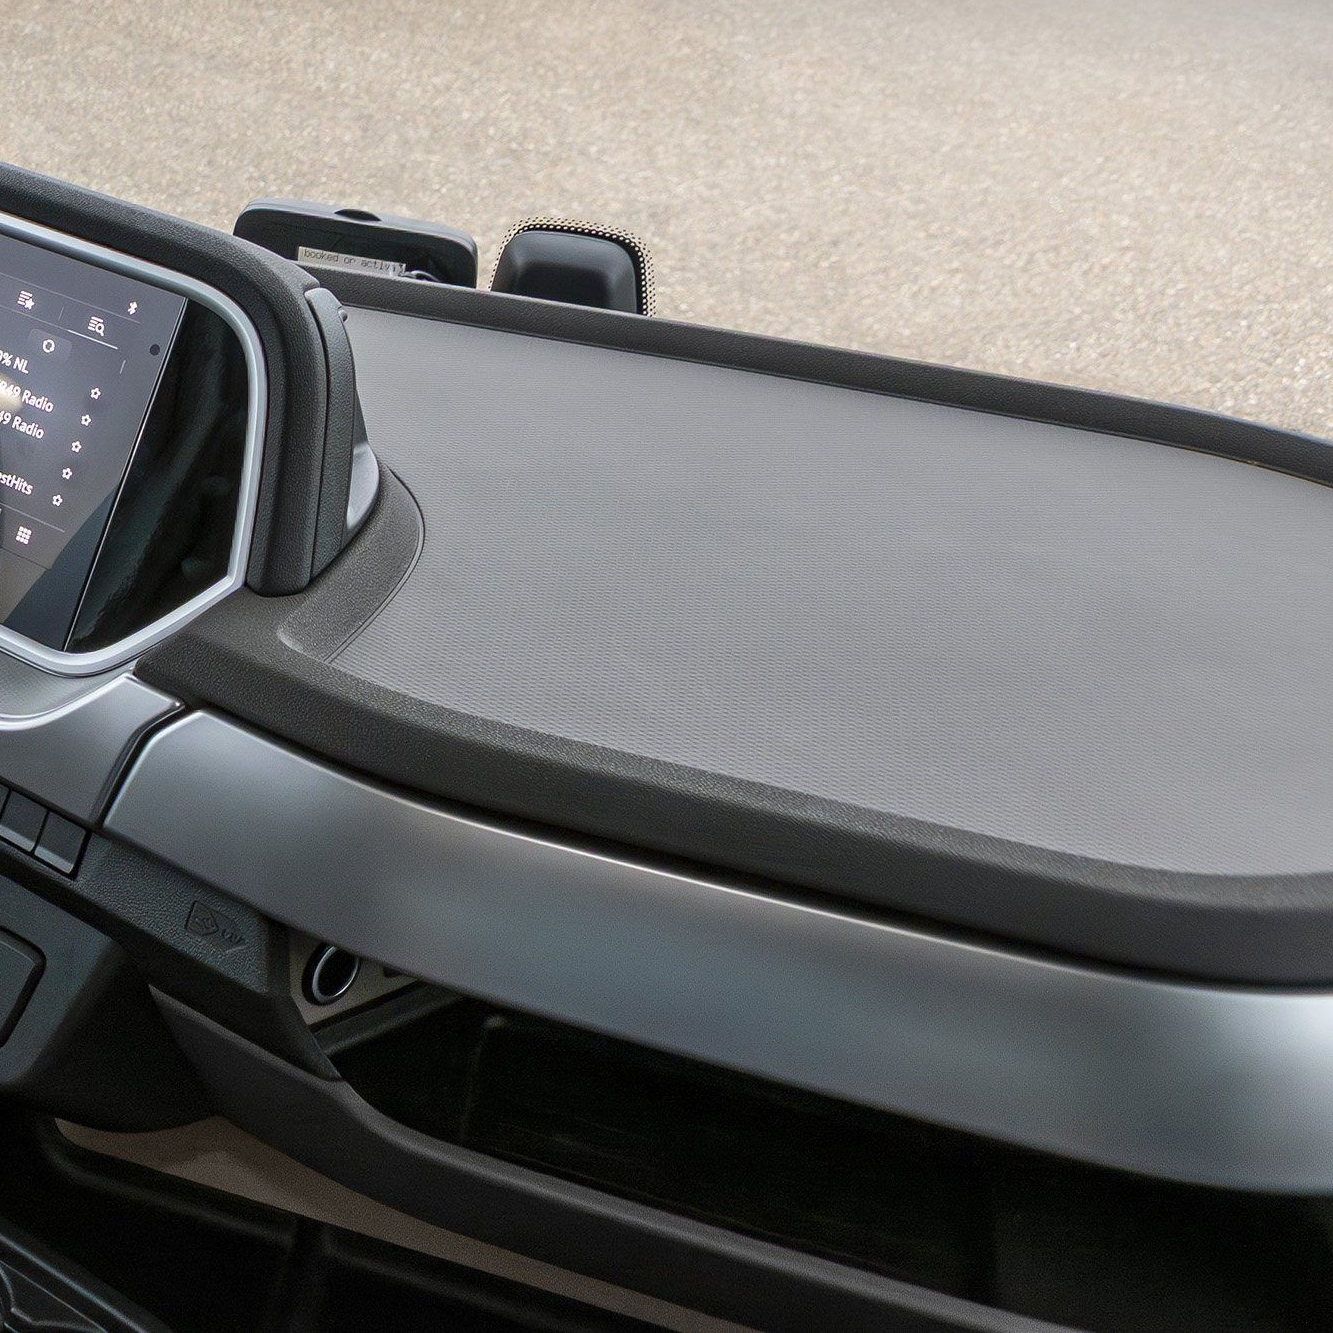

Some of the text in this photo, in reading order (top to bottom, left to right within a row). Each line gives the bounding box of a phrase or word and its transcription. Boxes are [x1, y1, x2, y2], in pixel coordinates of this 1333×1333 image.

[304, 248, 339, 263] booked
[12, 356, 29, 374] NL
[21, 389, 54, 413] Radio
[11, 416, 45, 440] Radio
